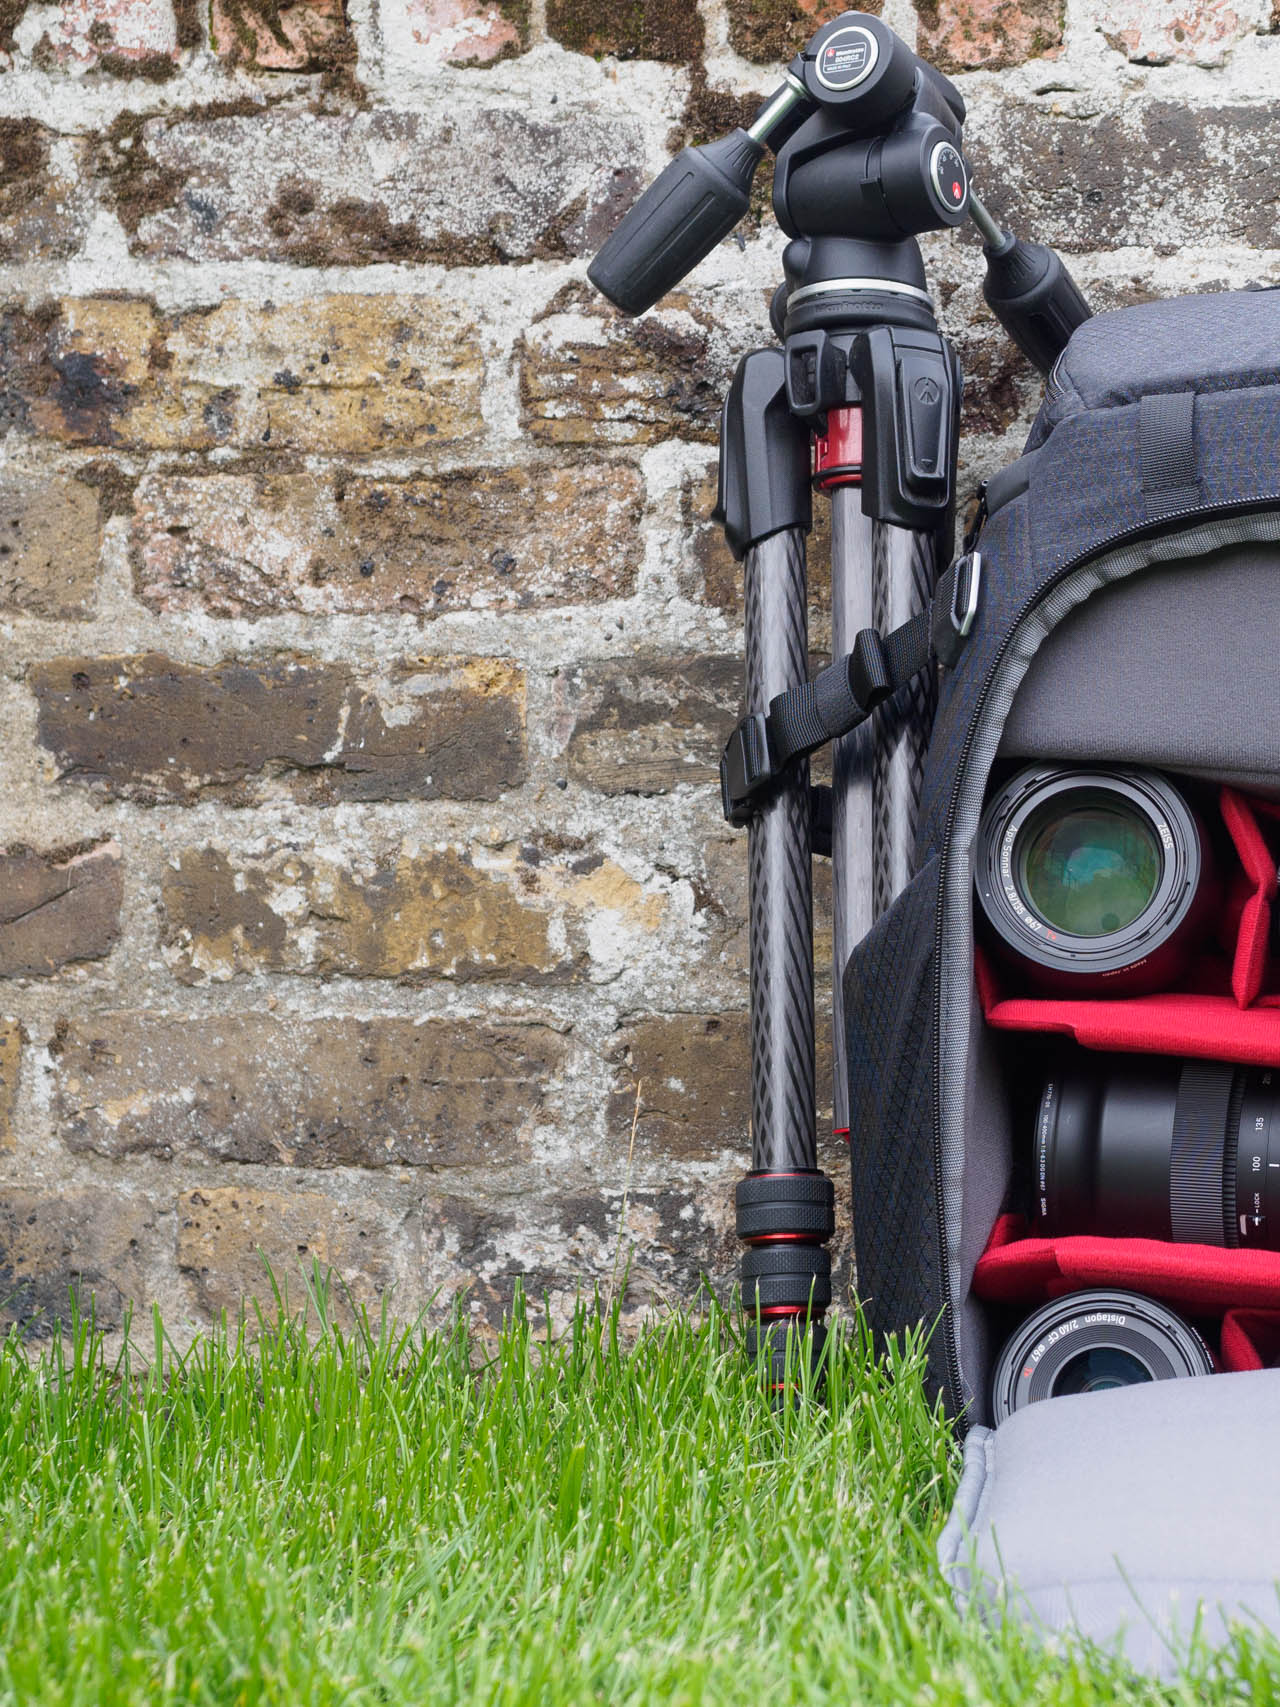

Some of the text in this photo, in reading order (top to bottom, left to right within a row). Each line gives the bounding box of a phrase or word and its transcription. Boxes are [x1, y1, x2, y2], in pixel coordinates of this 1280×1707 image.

[1005, 824, 1018, 843] Apo
[1157, 822, 1174, 849] ZEISS
[1002, 845, 1012, 878] Sonnar
[1255, 1117, 1265, 1131] 135
[1252, 1156, 1261, 1172] 100
[1084, 1312, 1126, 1325] Distagon
[1059, 1320, 1079, 1334] 2/40
[1048, 1331, 1059, 1344] CF
